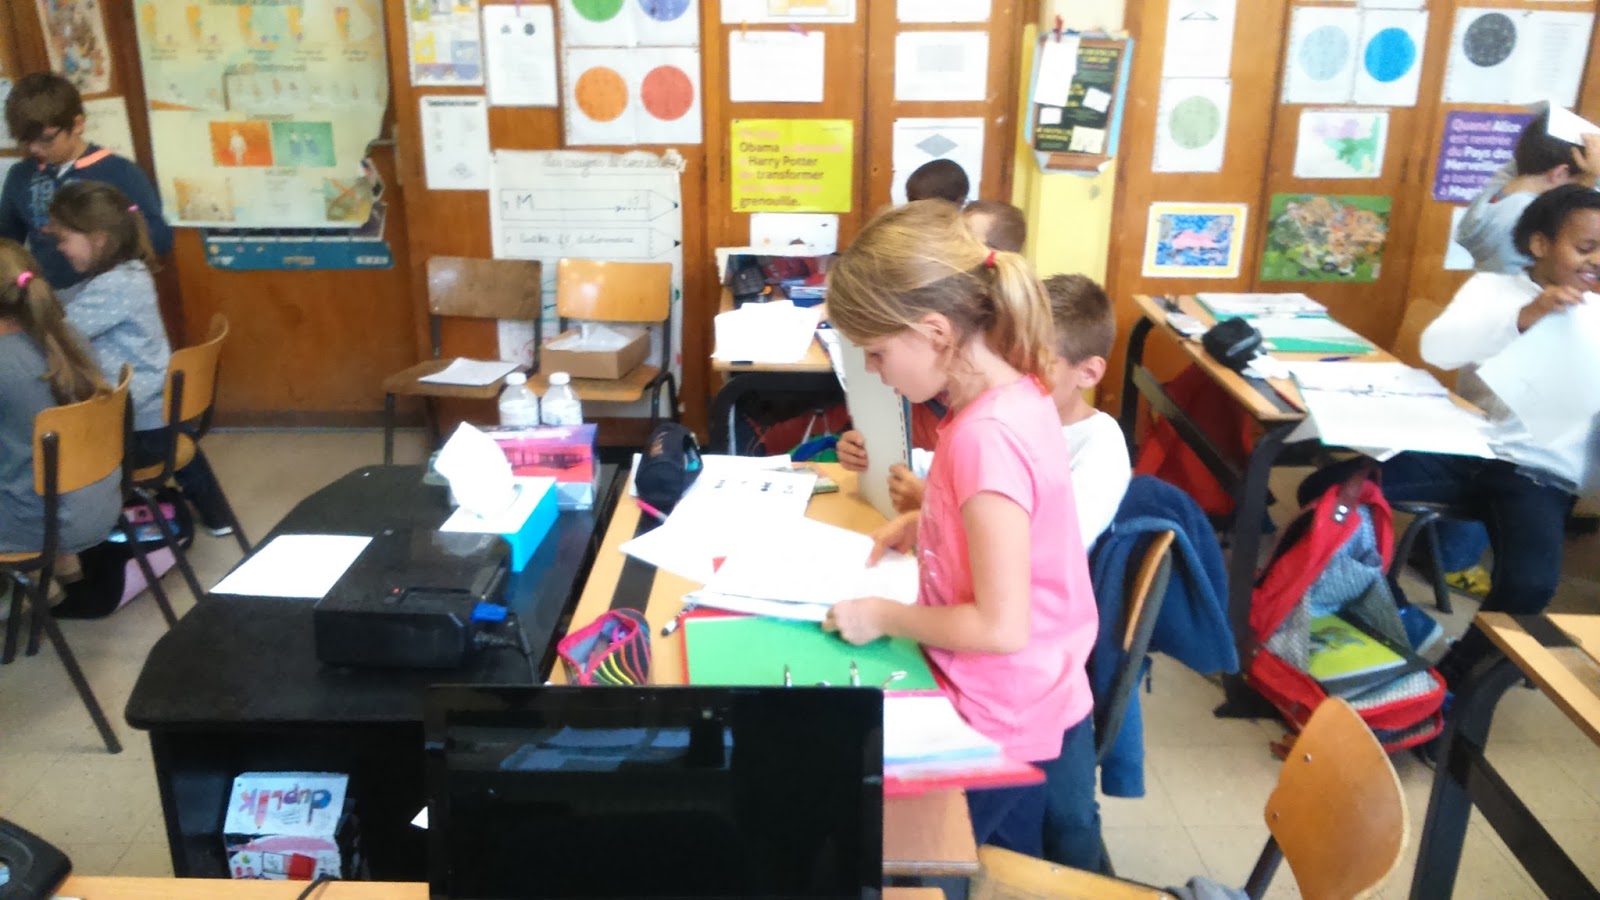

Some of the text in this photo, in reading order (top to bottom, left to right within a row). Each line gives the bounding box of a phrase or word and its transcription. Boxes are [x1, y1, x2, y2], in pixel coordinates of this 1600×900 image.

[1492, 120, 1522, 133] Alice
[739, 142, 780, 153] Obama
[1463, 146, 1491, 160] Pays
[748, 156, 780, 168] Harry
[782, 155, 818, 166] Potter
[756, 169, 824, 180] transformer
